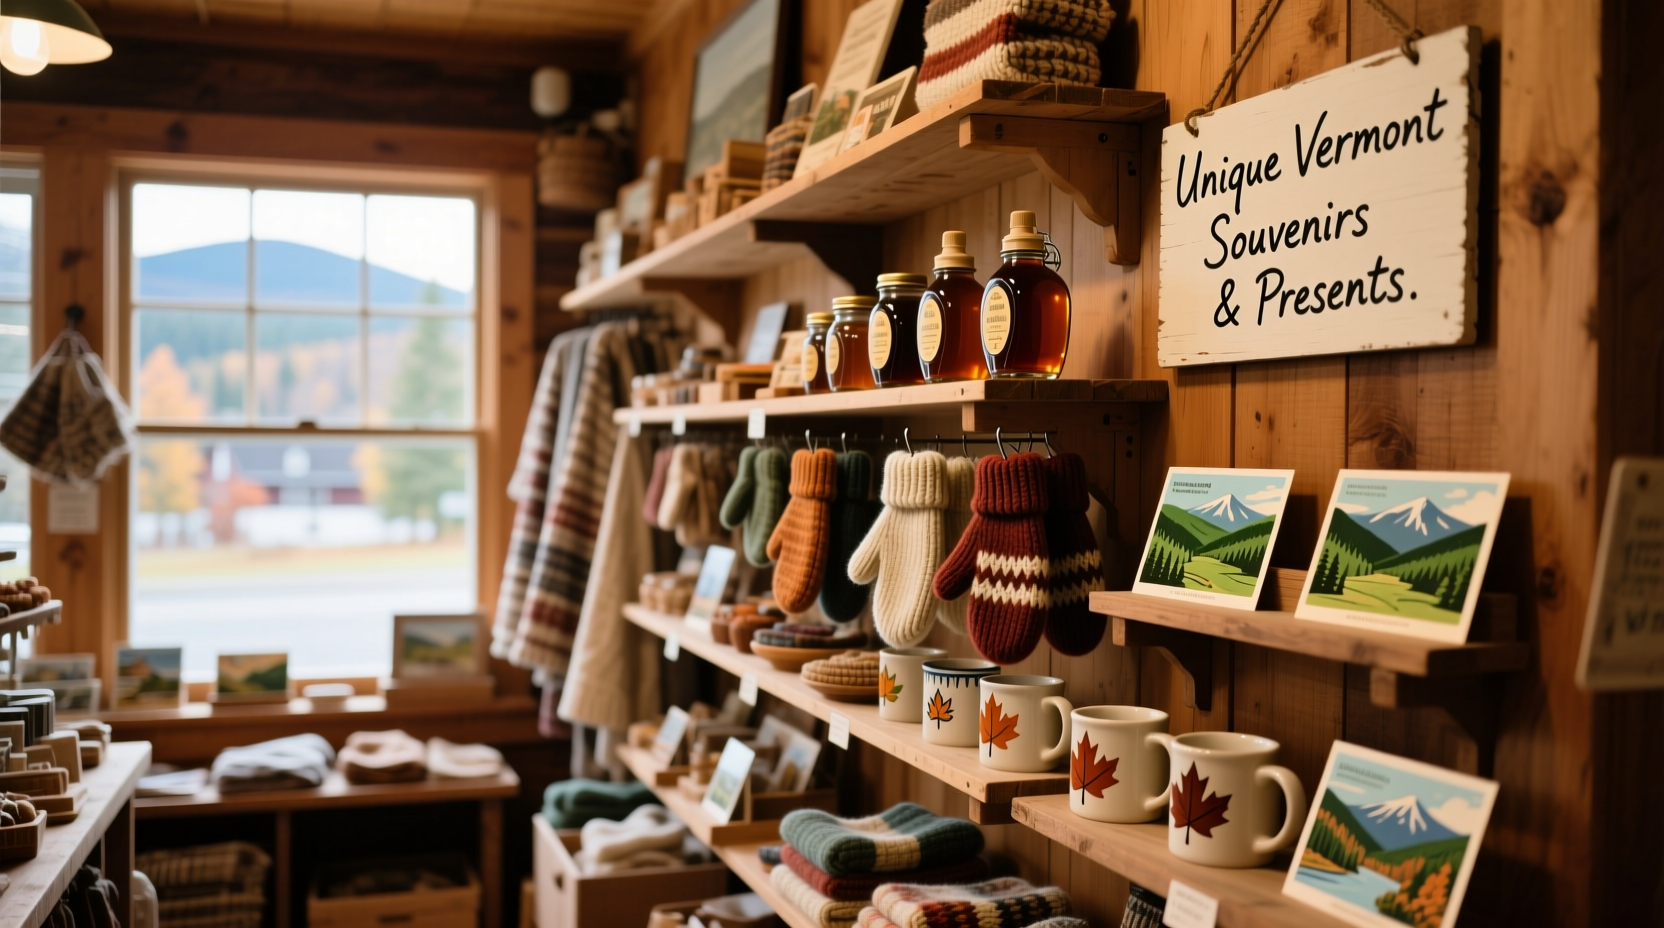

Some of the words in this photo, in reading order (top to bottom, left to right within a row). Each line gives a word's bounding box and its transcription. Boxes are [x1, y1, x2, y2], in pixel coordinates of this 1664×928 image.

[1176, 150, 1282, 215] Unique
[1295, 87, 1448, 177] Vermont
[1203, 201, 1370, 269] Souvenirs
[1213, 278, 1241, 328] &
[1255, 255, 1418, 326] Presents.
